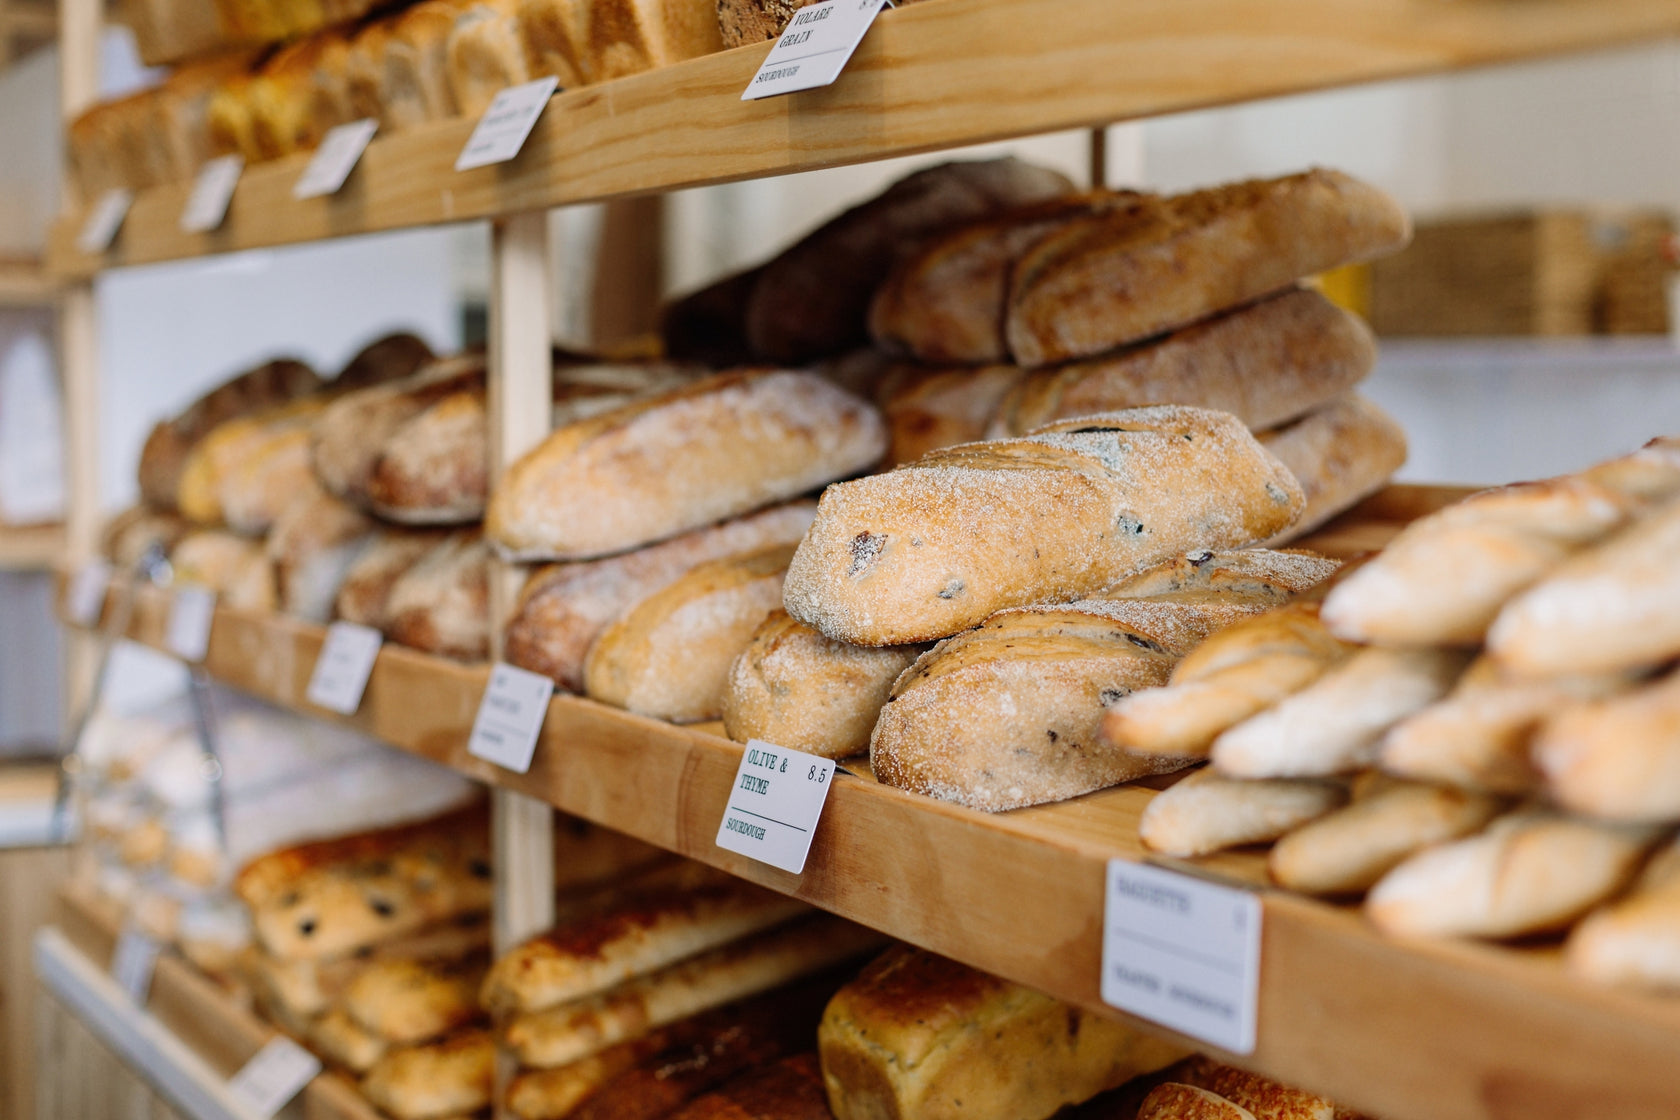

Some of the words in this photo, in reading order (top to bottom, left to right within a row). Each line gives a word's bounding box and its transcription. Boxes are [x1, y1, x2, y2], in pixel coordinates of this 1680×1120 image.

[794, 6, 834, 26] VOLARE
[779, 29, 814, 48] GRAIN
[747, 748, 778, 770] OLIVE
[779, 757, 788, 773] &
[740, 773, 770, 795] THYME
[807, 764, 828, 783] 8.5
[726, 817, 766, 841] SOURDOUGH
